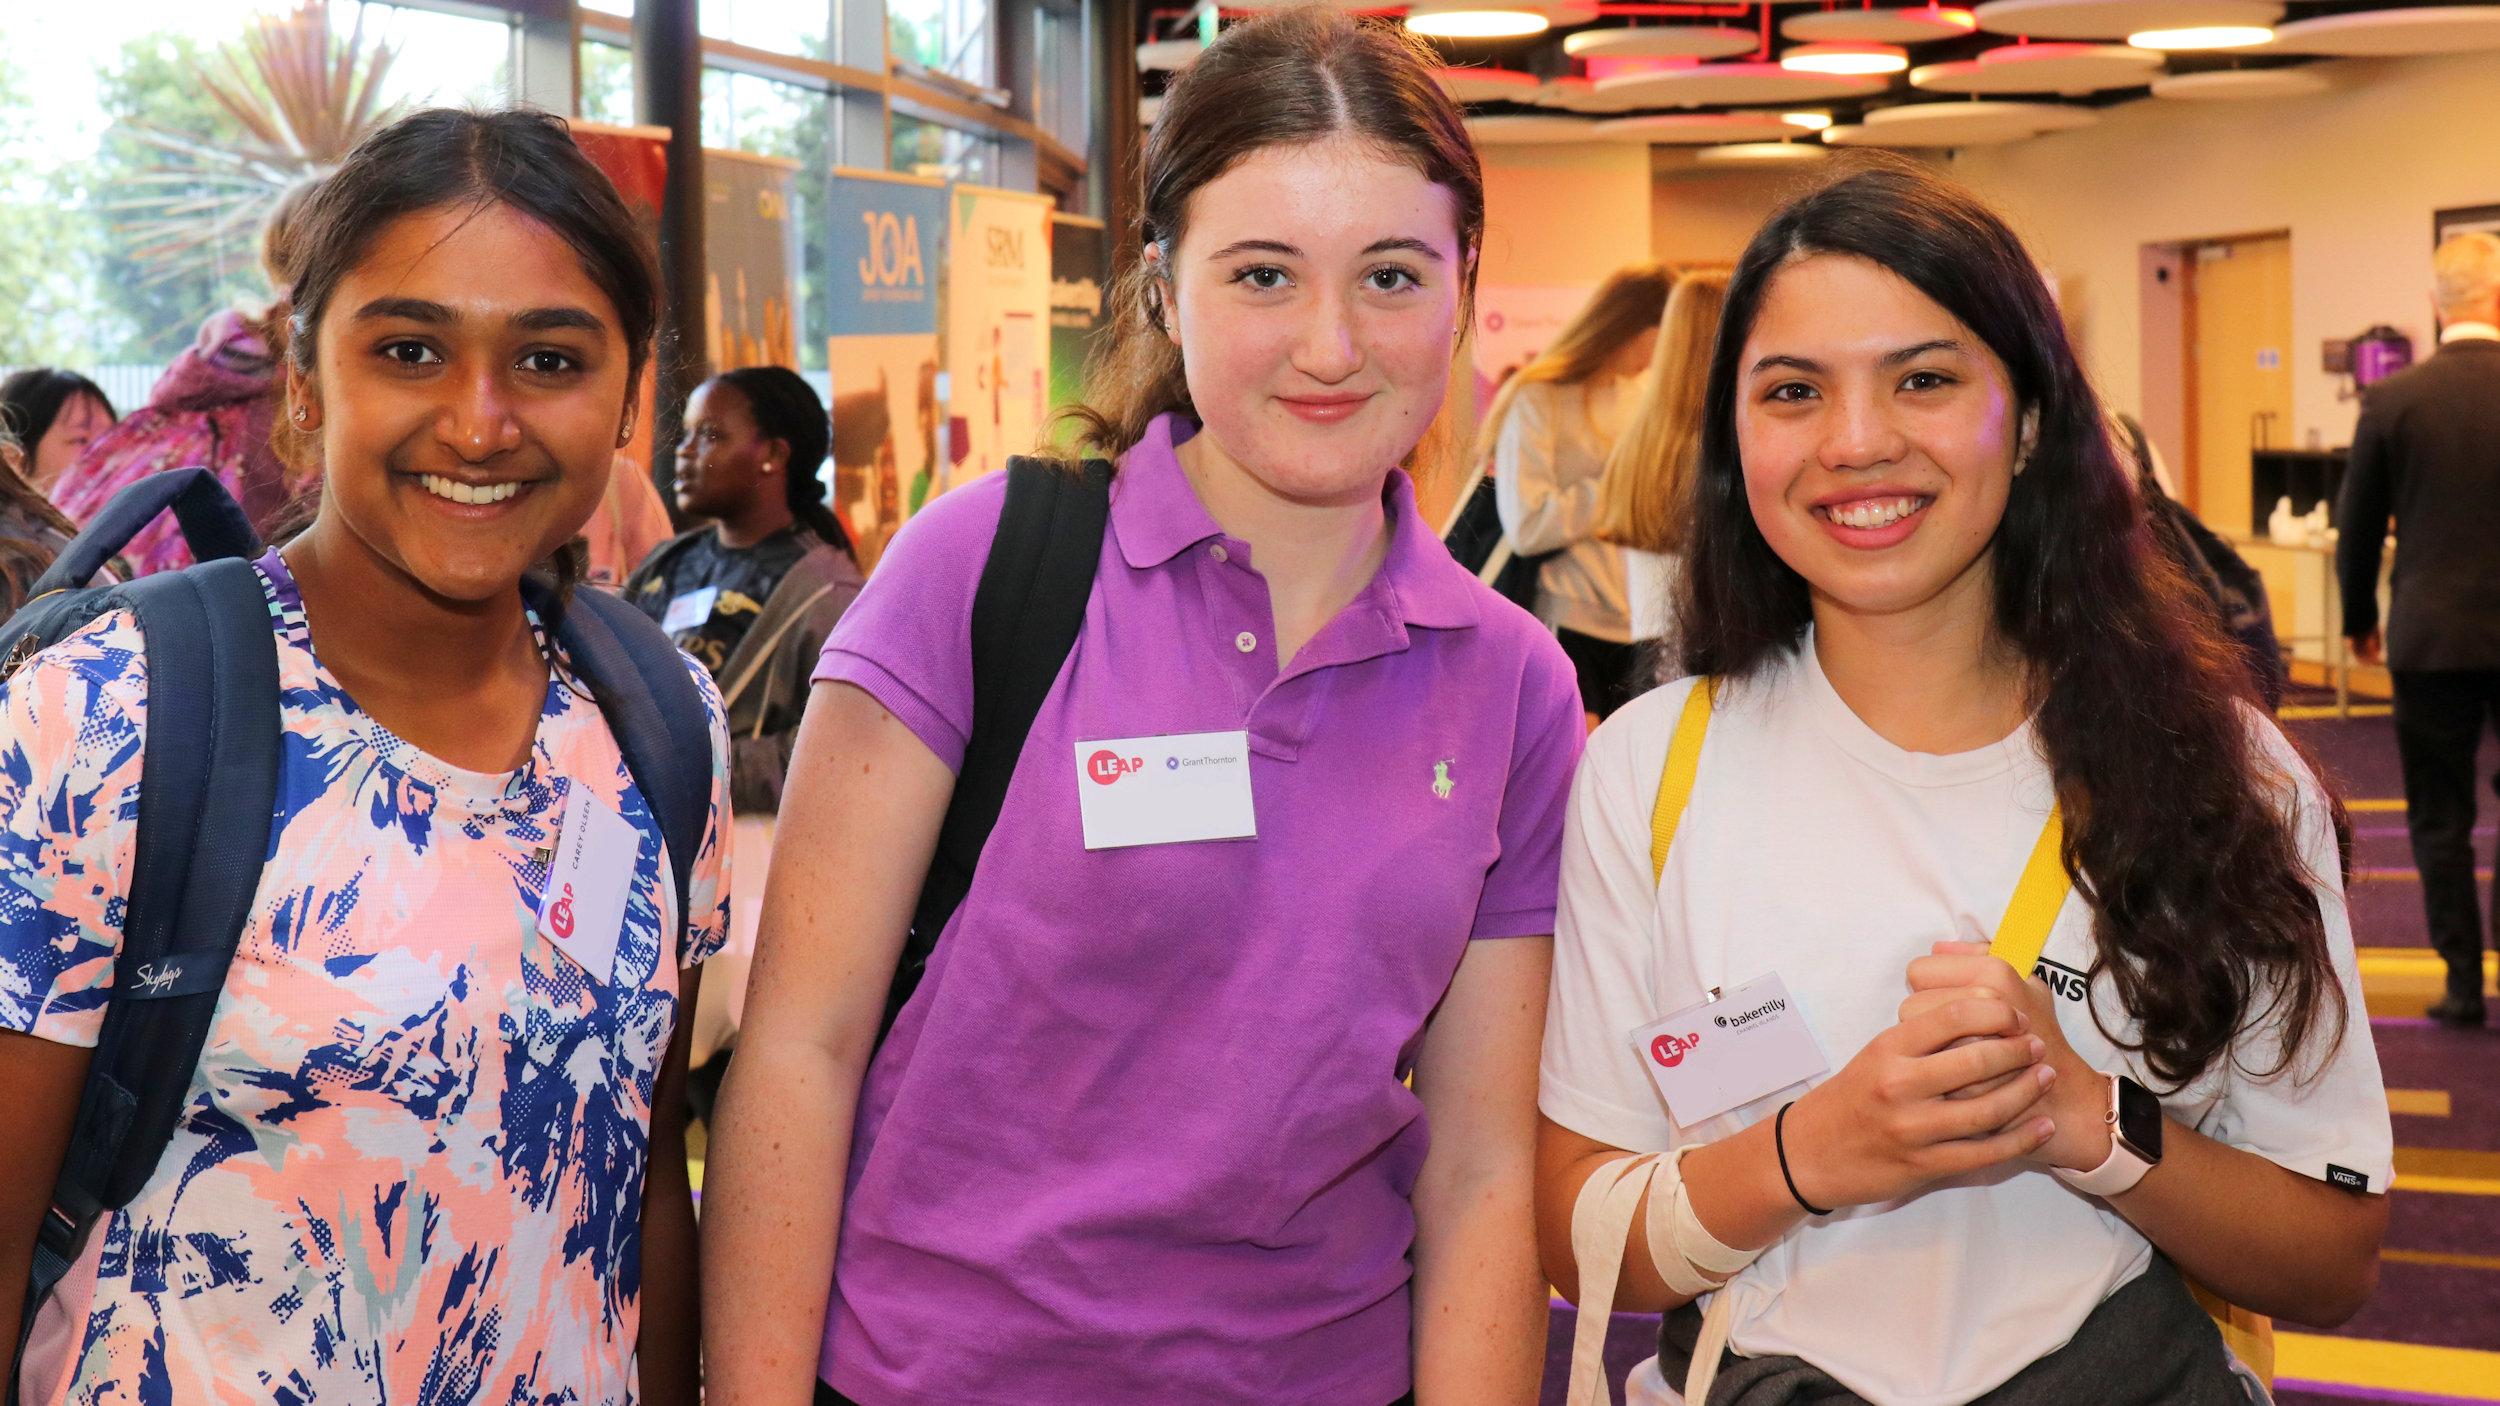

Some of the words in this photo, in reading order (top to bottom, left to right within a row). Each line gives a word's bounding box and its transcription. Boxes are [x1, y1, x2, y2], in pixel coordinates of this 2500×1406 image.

[859, 211, 924, 286] JOA
[1096, 756, 1143, 776] LEAP
[572, 836, 585, 870] CAREY
[581, 799, 592, 833] OLSEN
[554, 882, 575, 931] LEAP
[2033, 961, 2087, 1002] ANS
[1729, 998, 1786, 1028] bakertilly
[1657, 1032, 1699, 1060] LEAP
[2332, 1170, 2357, 1186] VANS
